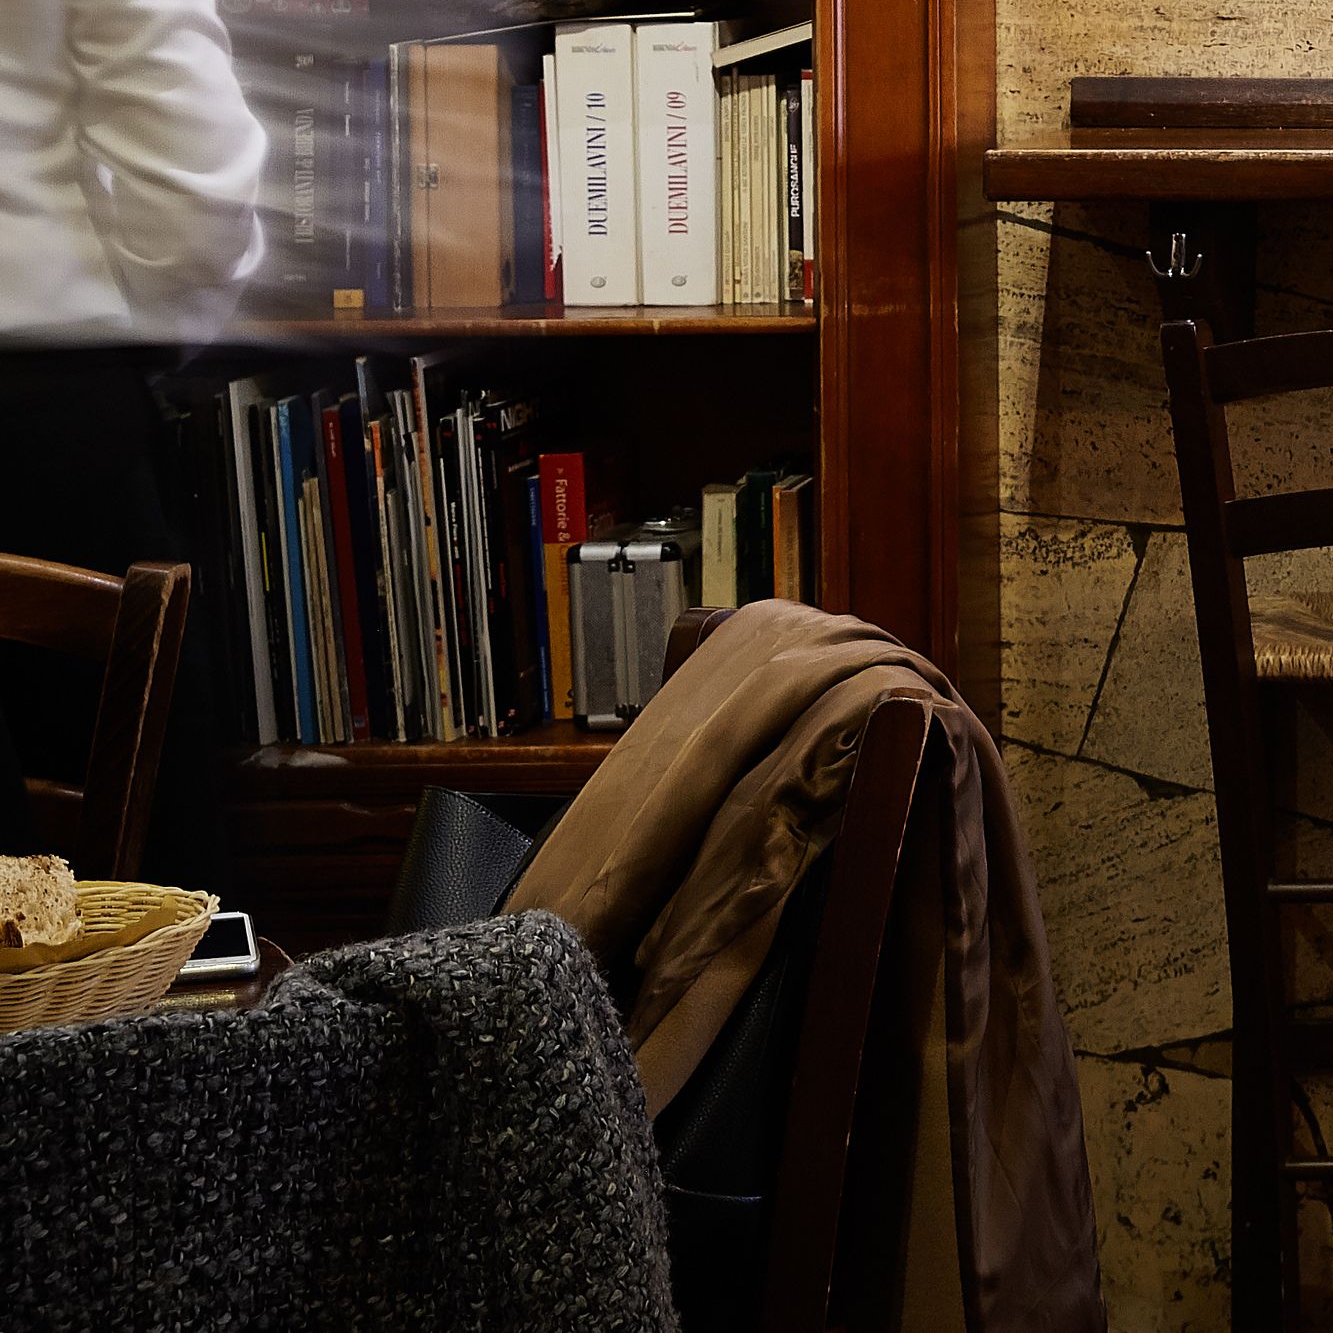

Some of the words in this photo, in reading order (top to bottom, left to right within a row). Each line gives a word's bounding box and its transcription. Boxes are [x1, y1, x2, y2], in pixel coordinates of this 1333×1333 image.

[586, 92, 606, 109] 10
[666, 91, 687, 109] 09
[586, 126, 608, 236] DUEMILAVINI
[666, 125, 689, 235] DUEMILAVINI
[555, 478, 570, 529] Fattorie
[557, 531, 571, 543] &
